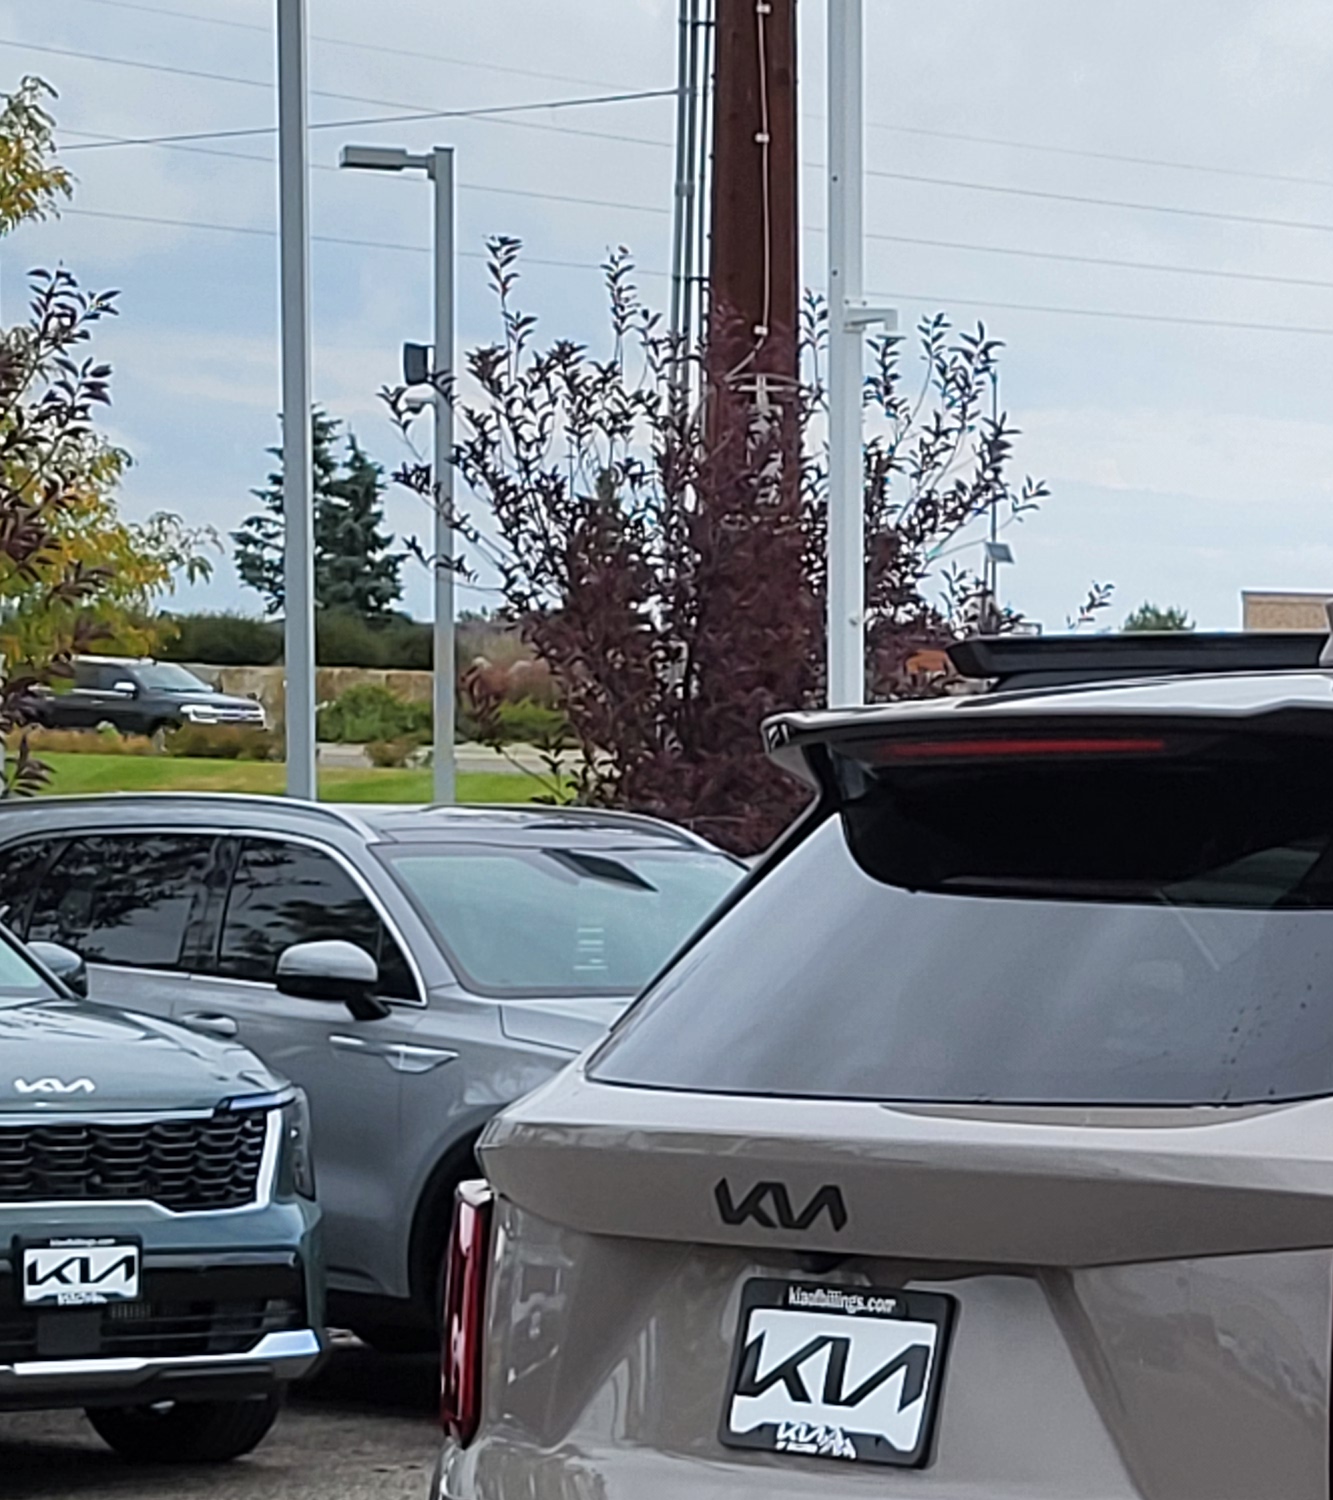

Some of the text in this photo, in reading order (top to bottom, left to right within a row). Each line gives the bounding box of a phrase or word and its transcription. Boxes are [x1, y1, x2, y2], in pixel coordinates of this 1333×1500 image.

[14, 1078, 96, 1093] KIA
[714, 1178, 848, 1232] KIA
[27, 1255, 135, 1286] KIA
[735, 1330, 931, 1413] KIA
